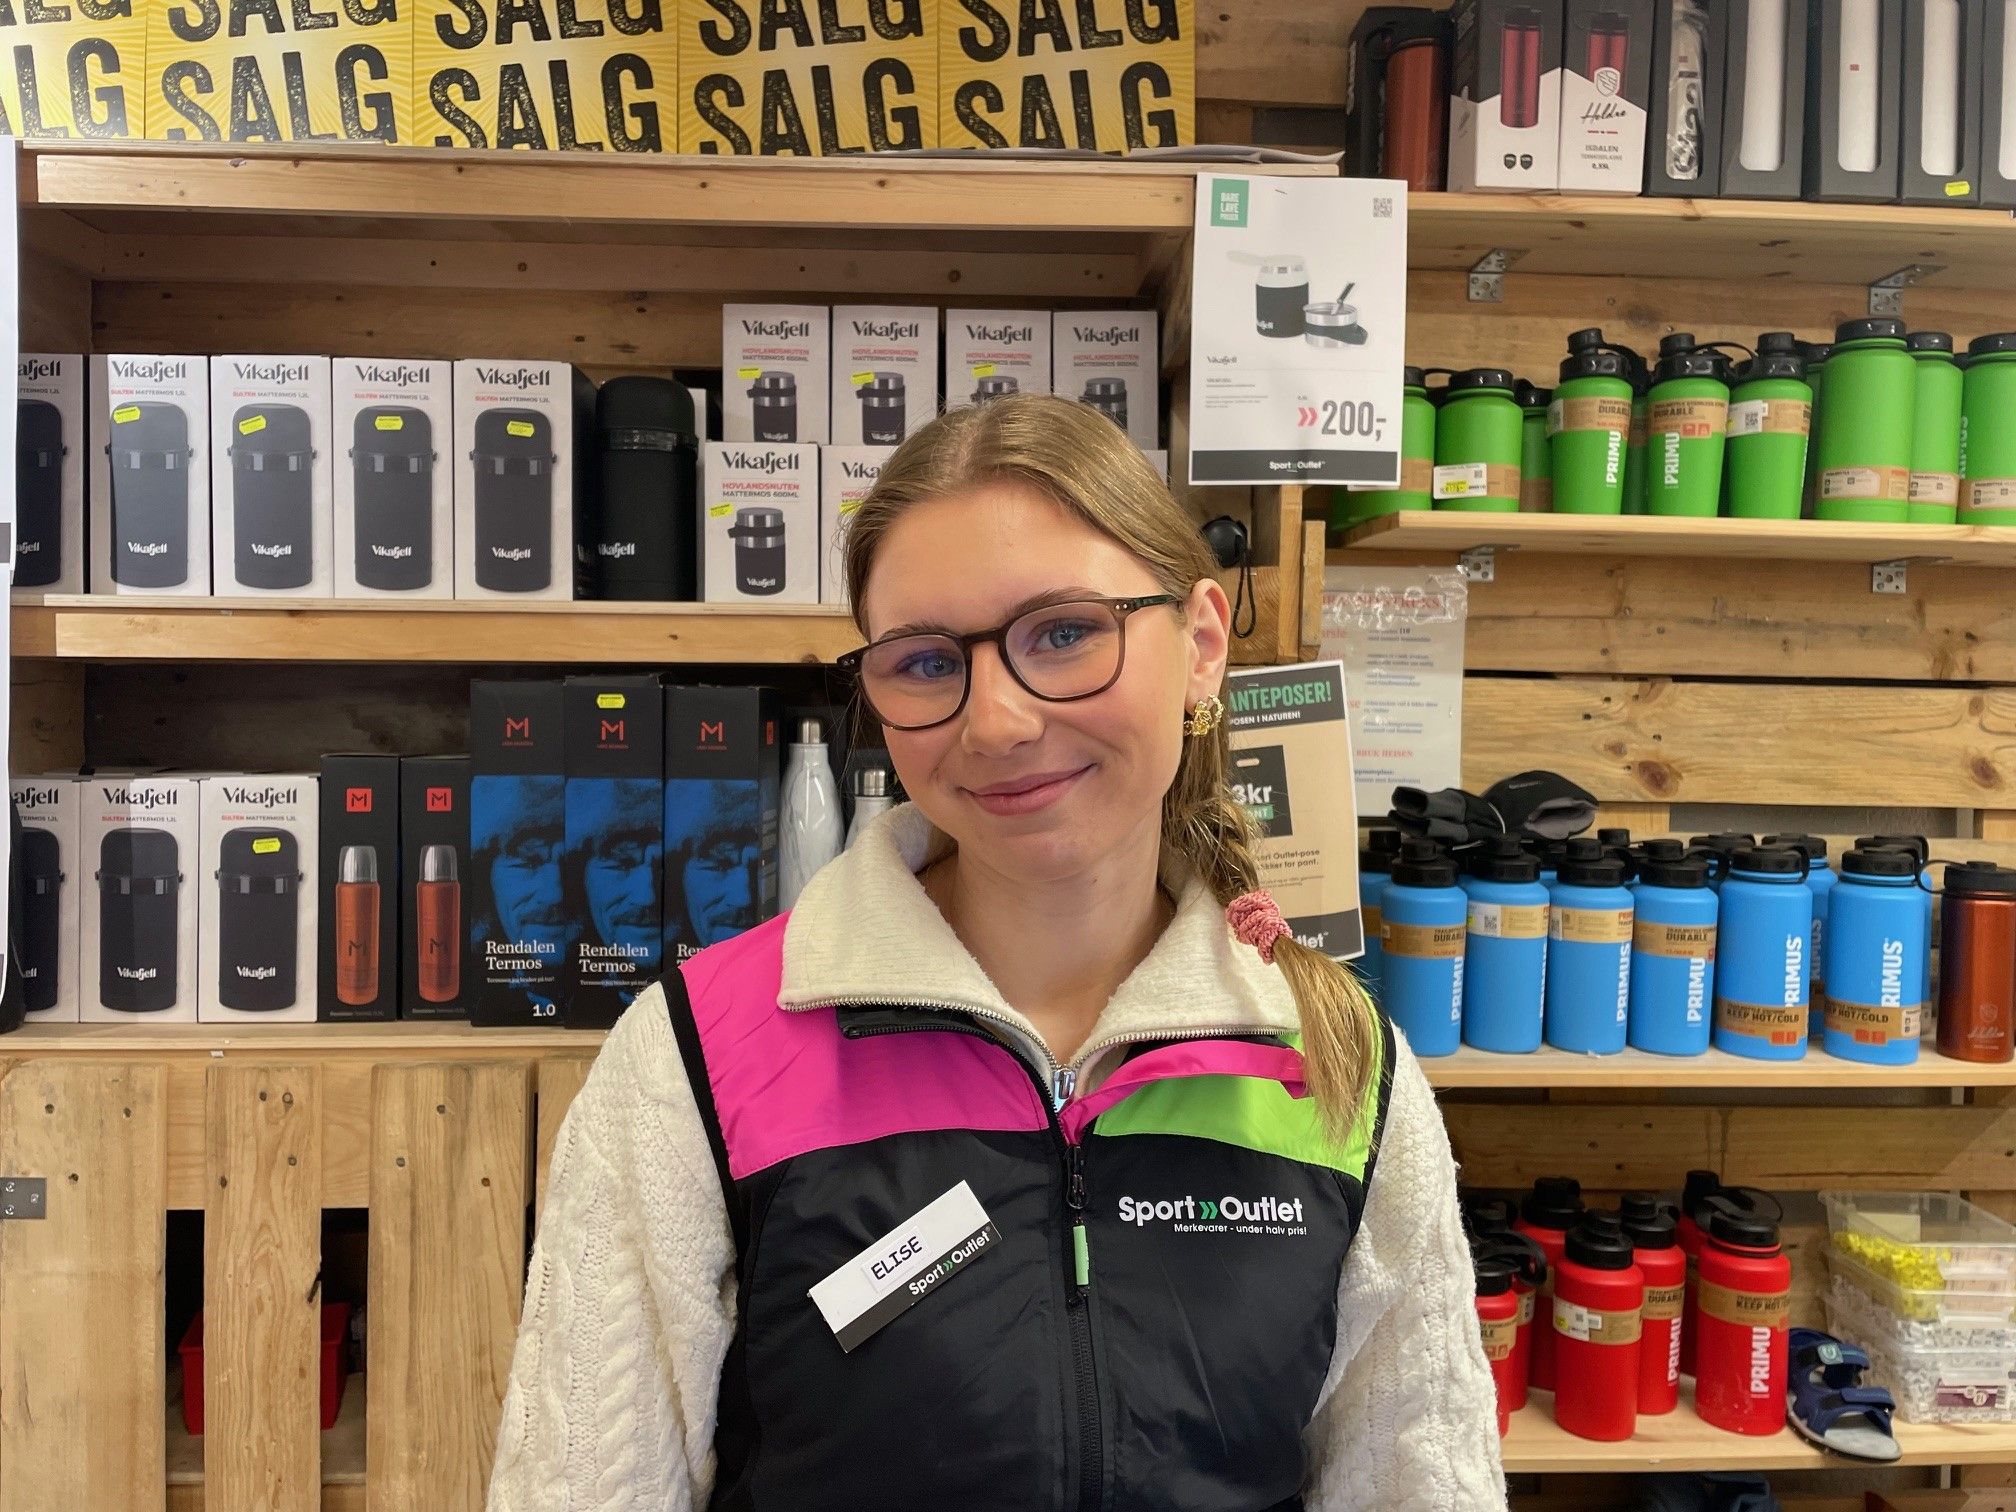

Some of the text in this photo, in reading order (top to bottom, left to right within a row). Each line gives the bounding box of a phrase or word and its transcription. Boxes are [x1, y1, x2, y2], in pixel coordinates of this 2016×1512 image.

[162, 44, 397, 142] SALG
[429, 53, 662, 152] SALG
[694, 58, 922, 156] SALG
[954, 61, 1178, 153] SALG
[742, 320, 809, 340] Vikafjell
[852, 321, 919, 341] Vikafjell
[966, 325, 1032, 345] Vikafjell
[1073, 326, 1139, 346] Vikafjell
[111, 360, 186, 383] Vikafjell
[233, 363, 309, 384] Vikafjell
[356, 365, 430, 387] Vikafjell
[476, 367, 550, 389] Vikafjell
[1321, 400, 1387, 441] 200,-
[721, 451, 799, 475] Vikafjell
[1269, 460, 1322, 470] Sport Outlet
[1664, 432, 1680, 485] PRIMU
[722, 482, 799, 490] HOVLANDSNUTEN
[722, 490, 771, 498] MATTERMOS
[128, 541, 167, 556] Vikafjell
[251, 543, 292, 557] Vikafjell
[371, 544, 412, 559] Vikafjell
[492, 546, 531, 561] Vikafjell
[1262, 711, 1301, 723] NATUREN!
[103, 787, 177, 809] Vikafjell
[223, 787, 297, 808] Vikafjell
[1285, 860, 1295, 869] for
[485, 940, 556, 954] Rendalen
[1665, 933, 1708, 942] DURABLE
[579, 943, 649, 957] Rendalen
[117, 966, 156, 981] Vikafjell
[236, 965, 276, 979] Vikafjell
[485, 957, 543, 970] Termos
[579, 960, 635, 972] Termos
[1785, 937, 1802, 1007] RIMUS
[1881, 940, 1903, 1007] RIMUS
[1616, 942, 1630, 1022] PRIMUS
[1687, 958, 1706, 1022] PRIMU
[532, 1004, 556, 1017] 1.0
[1727, 1008, 1800, 1024] KEEP HOT/COLD
[1118, 1195, 1303, 1227] Sport Outlet
[1174, 1223, 1228, 1232] Merkevarer
[1236, 1224, 1263, 1234] under
[1265, 1225, 1286, 1235] halv
[1287, 1227, 1307, 1236] pris!
[870, 1235, 923, 1281] ELISE
[908, 1230, 991, 1296] Sport Outlet
[1751, 1326, 1771, 1393] PRIMU
